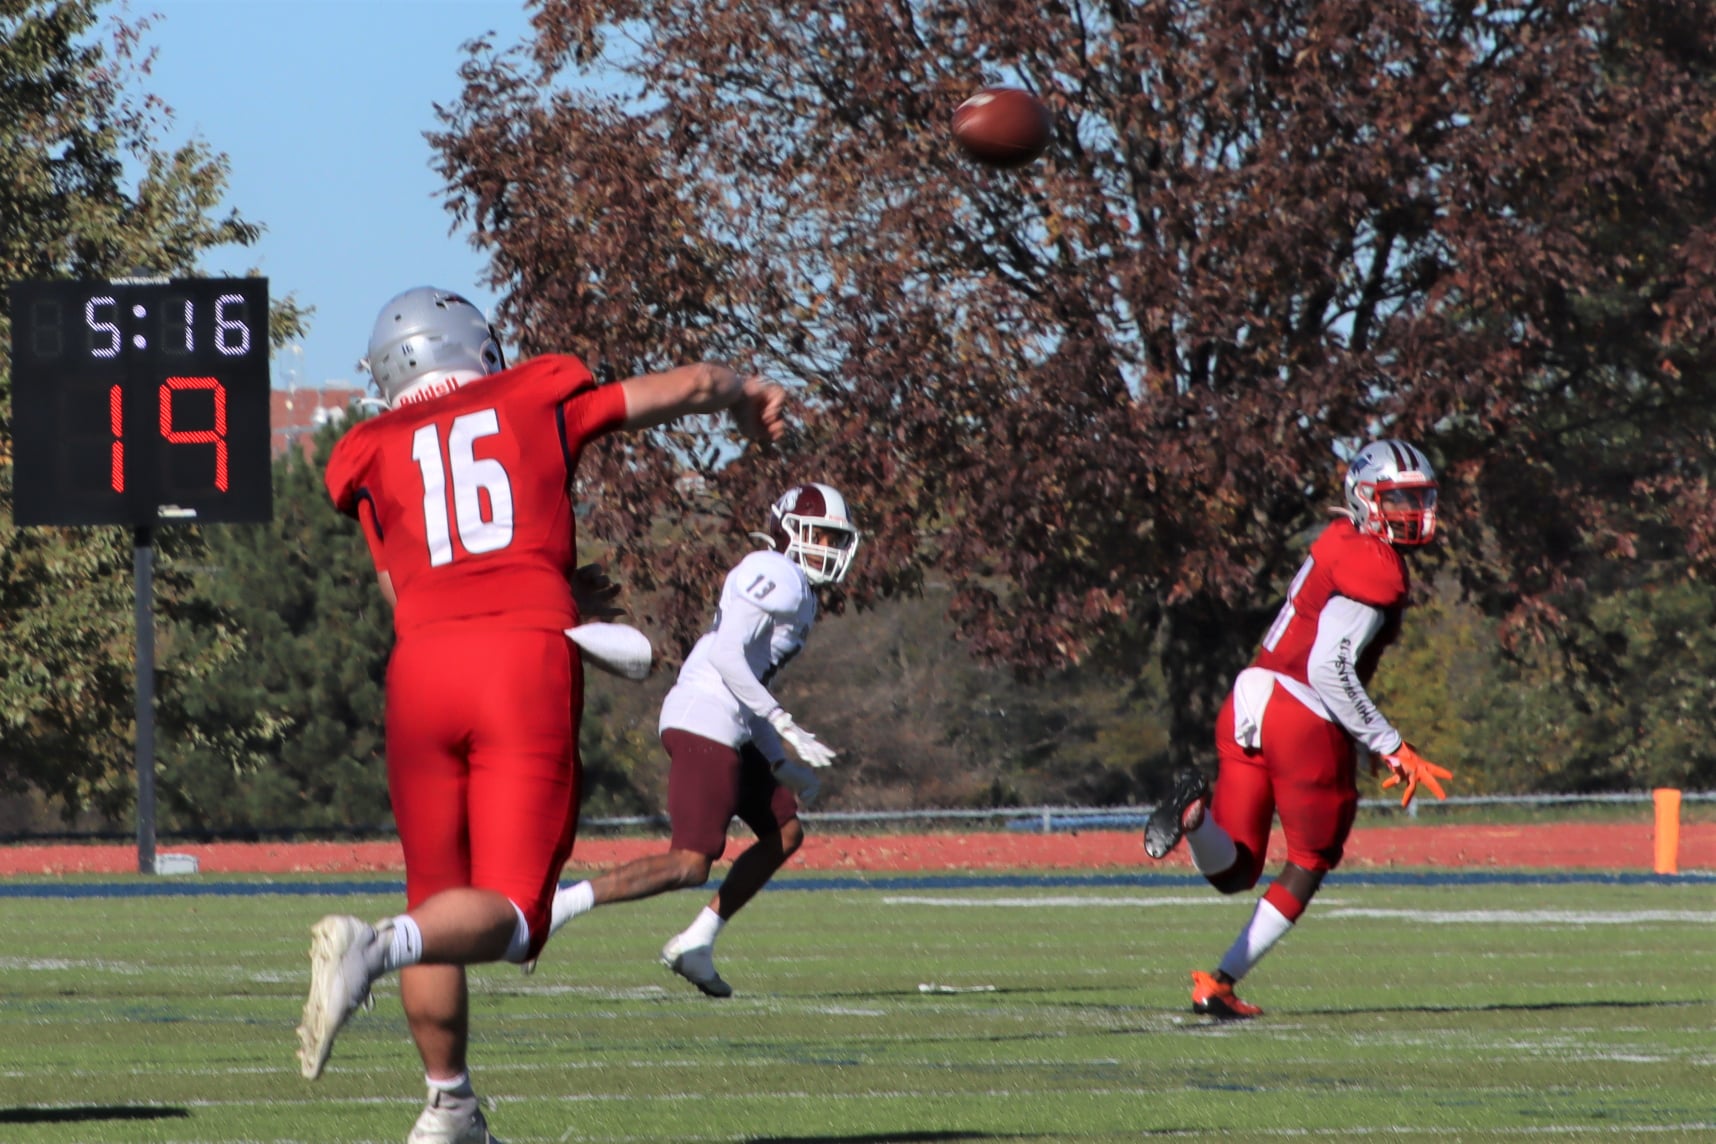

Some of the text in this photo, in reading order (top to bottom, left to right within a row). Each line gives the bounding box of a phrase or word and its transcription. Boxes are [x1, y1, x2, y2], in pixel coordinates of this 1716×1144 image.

[85, 293, 250, 358] 5:16
[109, 376, 229, 494] 19
[411, 407, 515, 568] 16
[746, 573, 777, 600] 13
